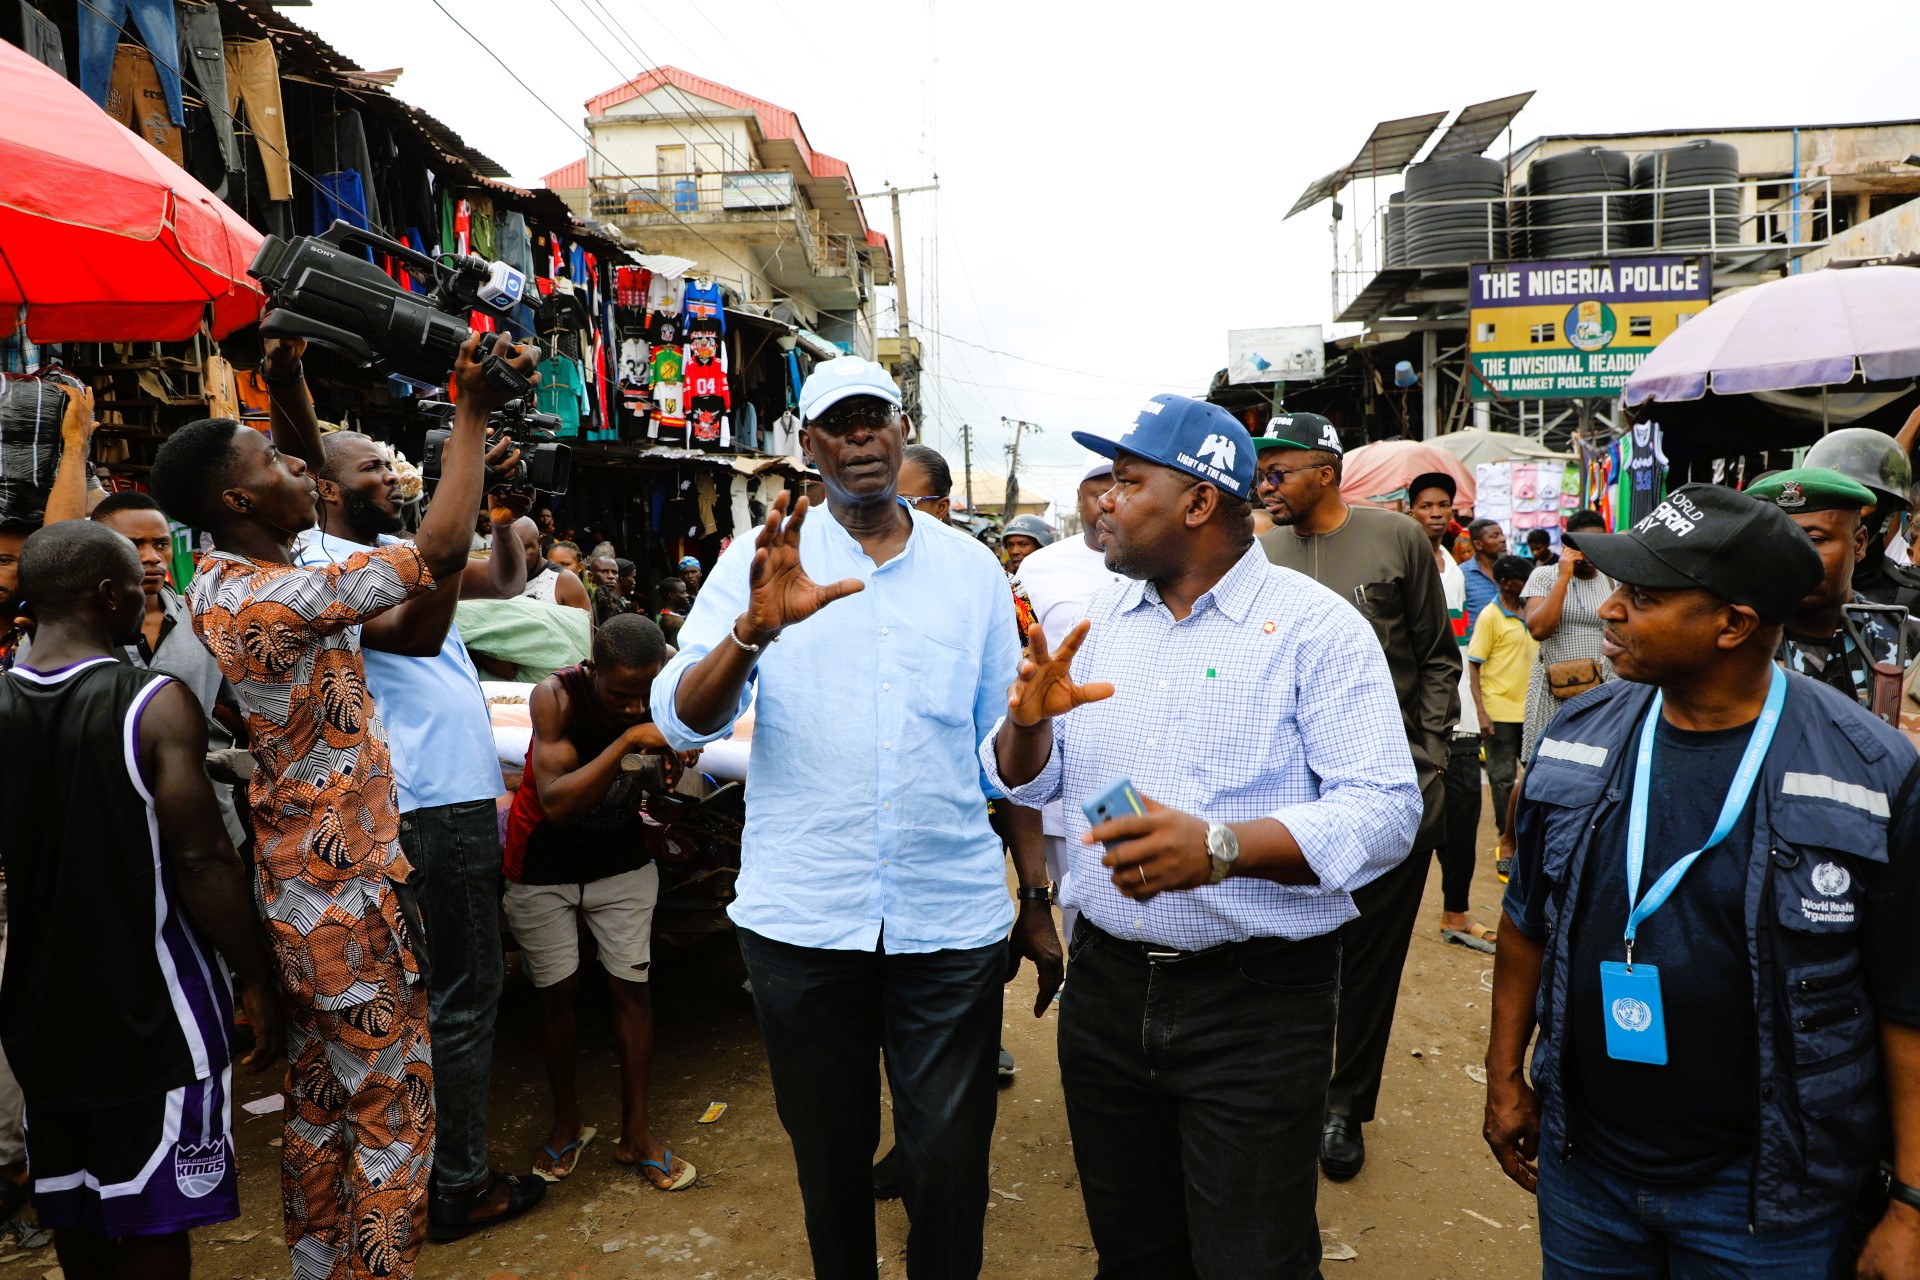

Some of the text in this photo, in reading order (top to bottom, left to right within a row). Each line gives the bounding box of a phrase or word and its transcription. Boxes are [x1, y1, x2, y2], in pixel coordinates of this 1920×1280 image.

[310, 245, 336, 259] SONY
[1479, 265, 1699, 299] THE NIGERIA POLICE
[1481, 353, 1648, 376] THE DIVISIONAL HEADQU
[500, 371, 519, 388] SONY
[696, 378, 715, 394] 04
[1511, 377, 1554, 391] MARKET
[1557, 376, 1596, 390] POLICE
[1600, 375, 1628, 388] STAT
[1176, 452, 1240, 491] LIGHT OF THE NATION
[1633, 516, 1661, 534] AY
[1650, 502, 1695, 537] ARIA
[1755, 723, 1770, 747] UNITED
[1742, 747, 1759, 778] NATIONS
[1631, 832, 1640, 862] NATIONS
[1658, 868, 1680, 894] NATIONS
[1801, 898, 1829, 912] World
[177, 1162, 224, 1178] KINGS
